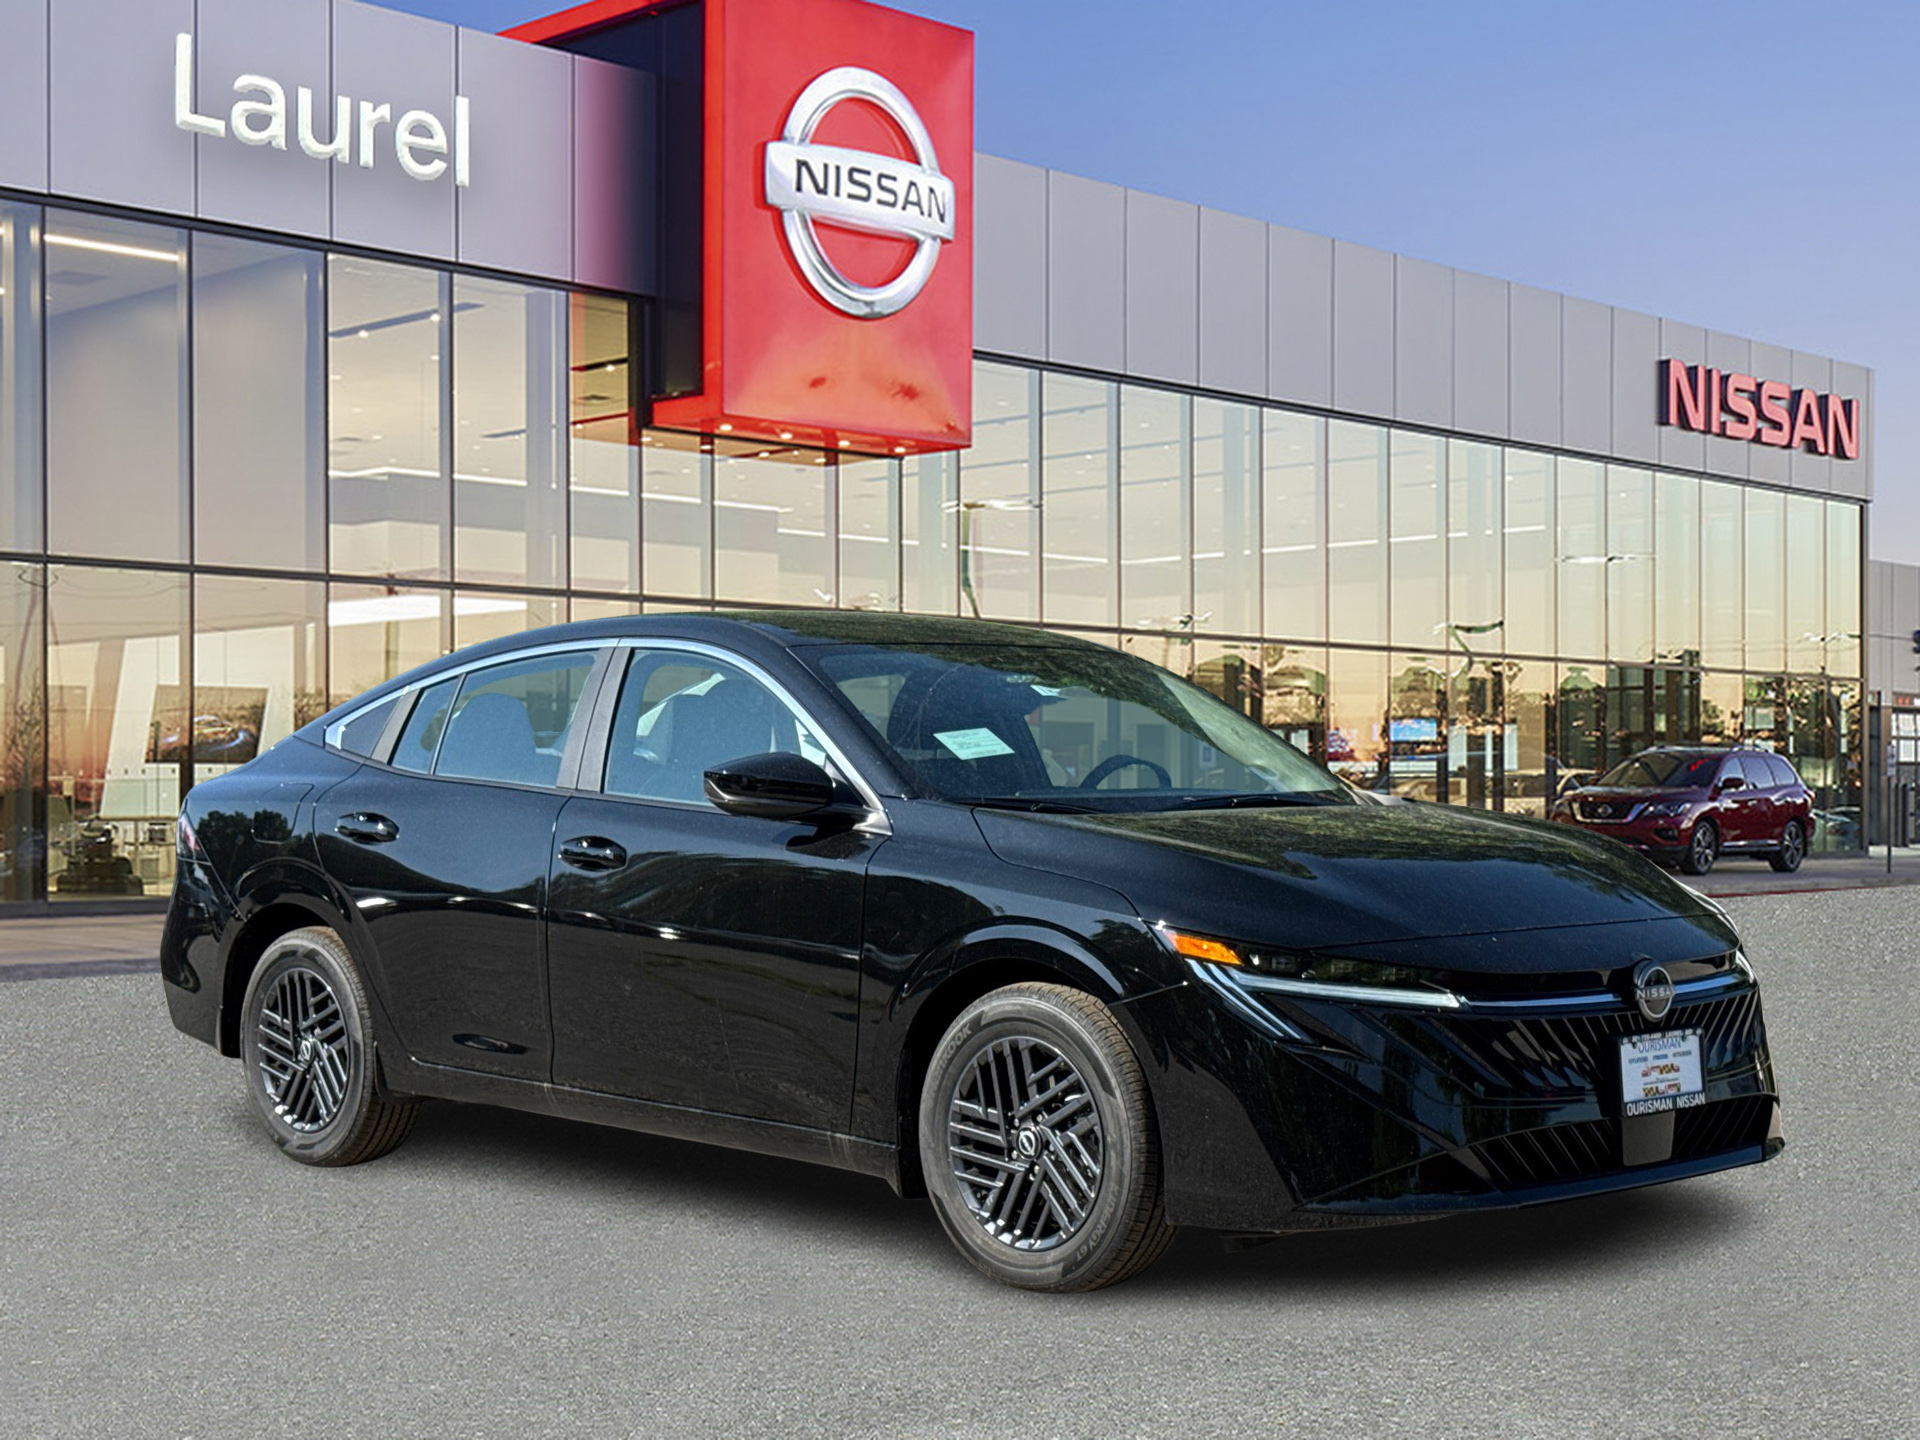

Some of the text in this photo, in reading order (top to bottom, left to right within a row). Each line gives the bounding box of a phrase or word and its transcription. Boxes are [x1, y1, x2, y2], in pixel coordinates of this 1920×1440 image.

[174, 32, 470, 187] Laurel
[795, 158, 946, 224] NISSAN
[1659, 357, 1860, 460] NISSAN
[1626, 1092, 1706, 1116] OURISMAN NISSAN
